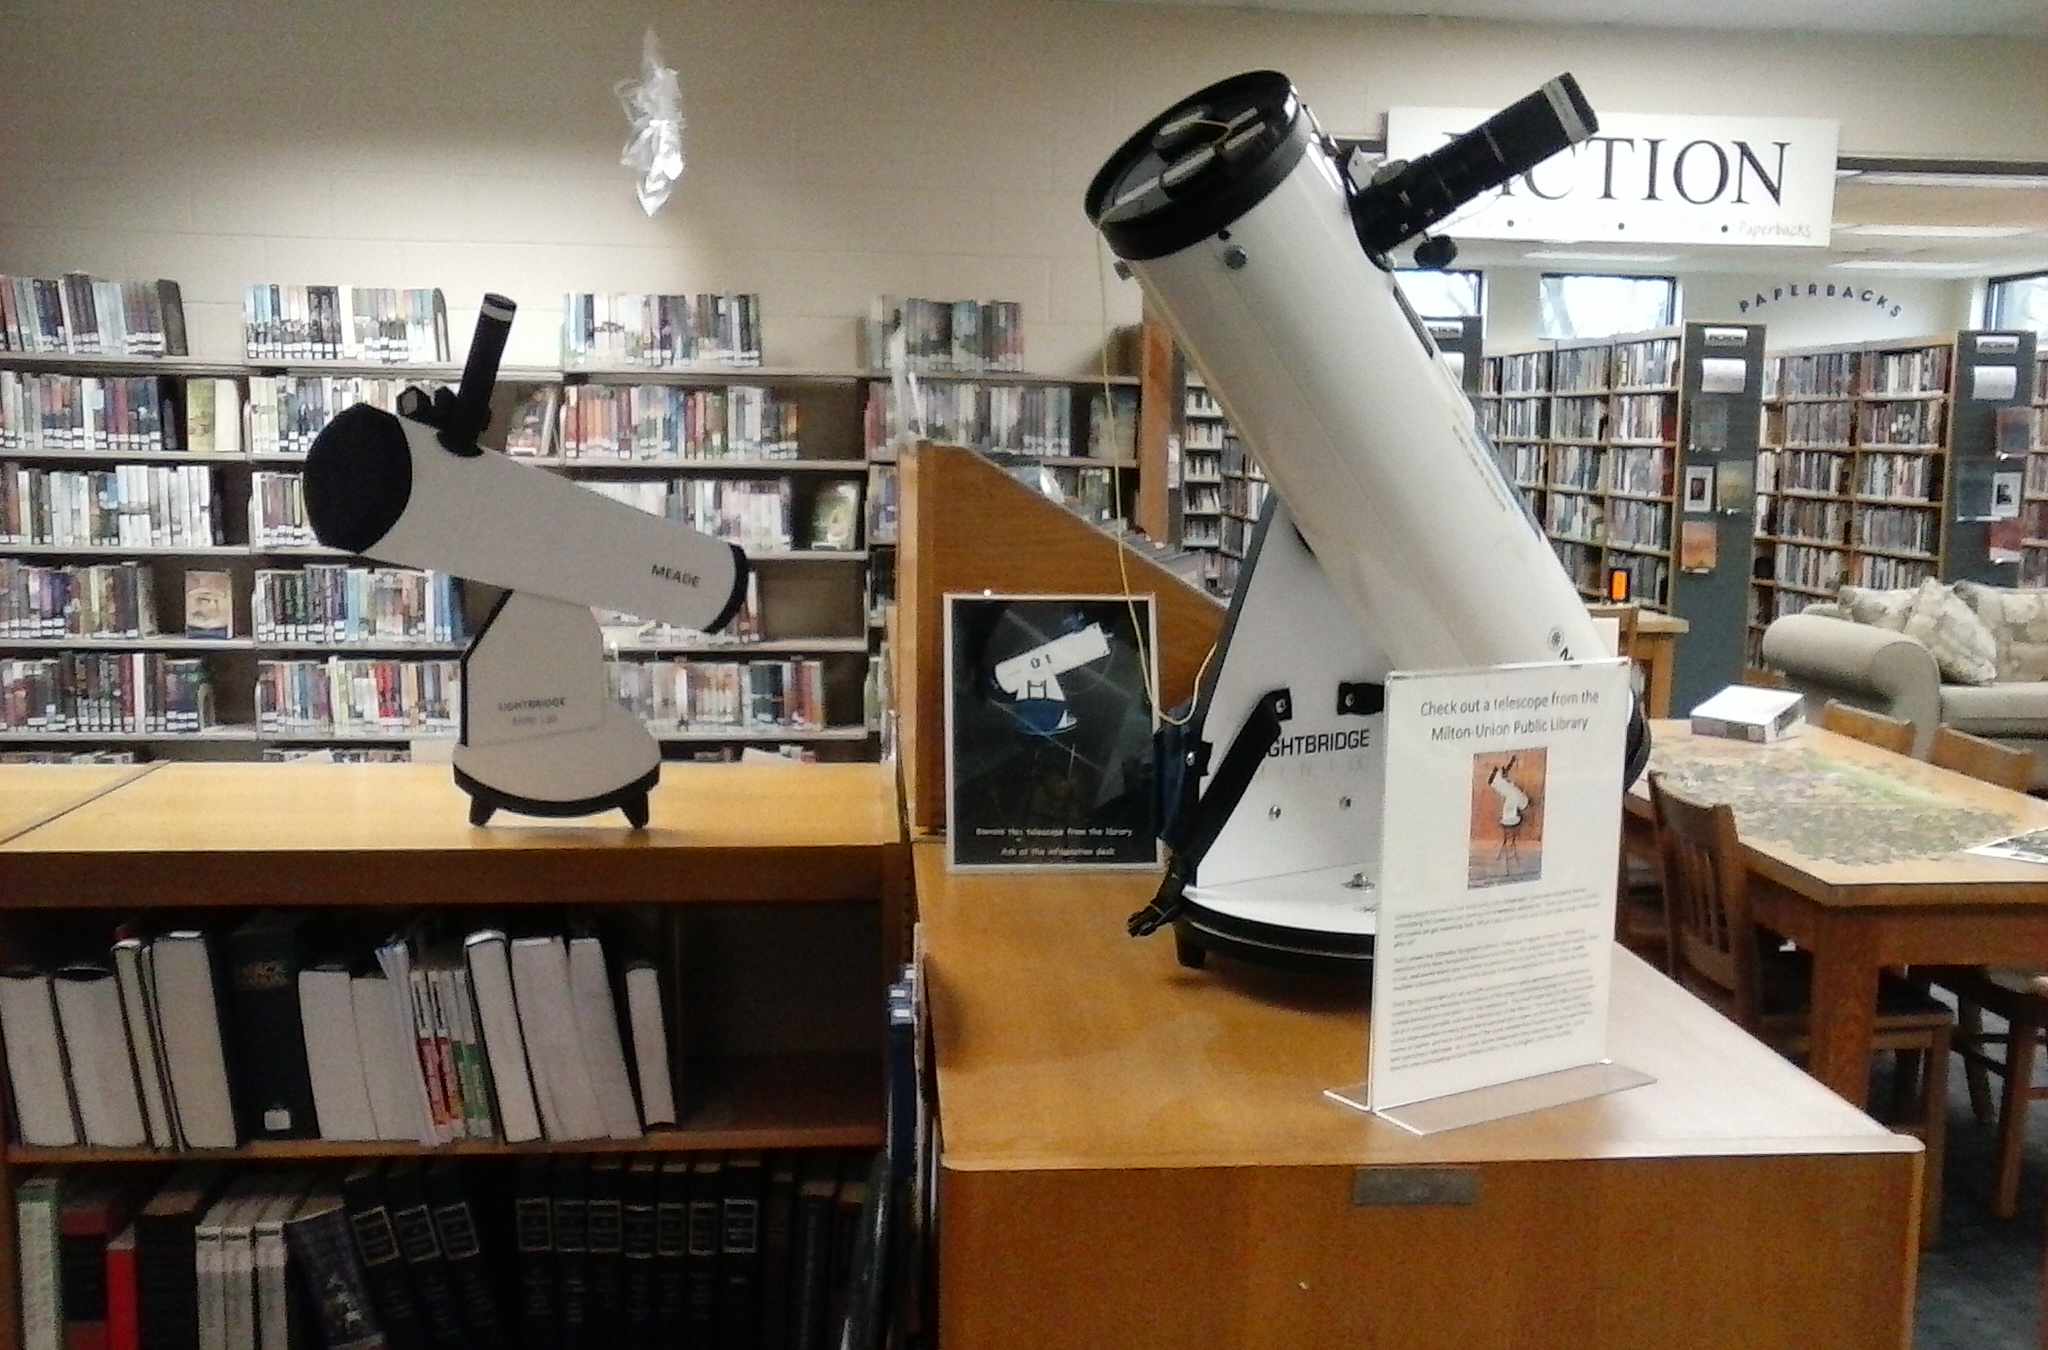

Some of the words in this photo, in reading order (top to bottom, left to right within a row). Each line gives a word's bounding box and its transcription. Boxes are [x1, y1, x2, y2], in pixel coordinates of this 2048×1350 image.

[1443, 131, 1792, 206] CTION
[1739, 220, 1811, 238] Paperbacks
[1738, 282, 1902, 318] PAPERBACKS
[651, 564, 701, 588] MEADE
[1421, 700, 1458, 717] Check
[1459, 699, 1480, 714] out
[1484, 700, 1491, 712] a
[1494, 695, 1549, 712] telescope
[1552, 690, 1578, 707] from
[1581, 689, 1600, 705] the
[1431, 723, 1510, 742] Milton-Union
[1513, 718, 1548, 735] Public
[1550, 715, 1589, 732] Library
[1267, 728, 1371, 758] GHTBRIDGE
